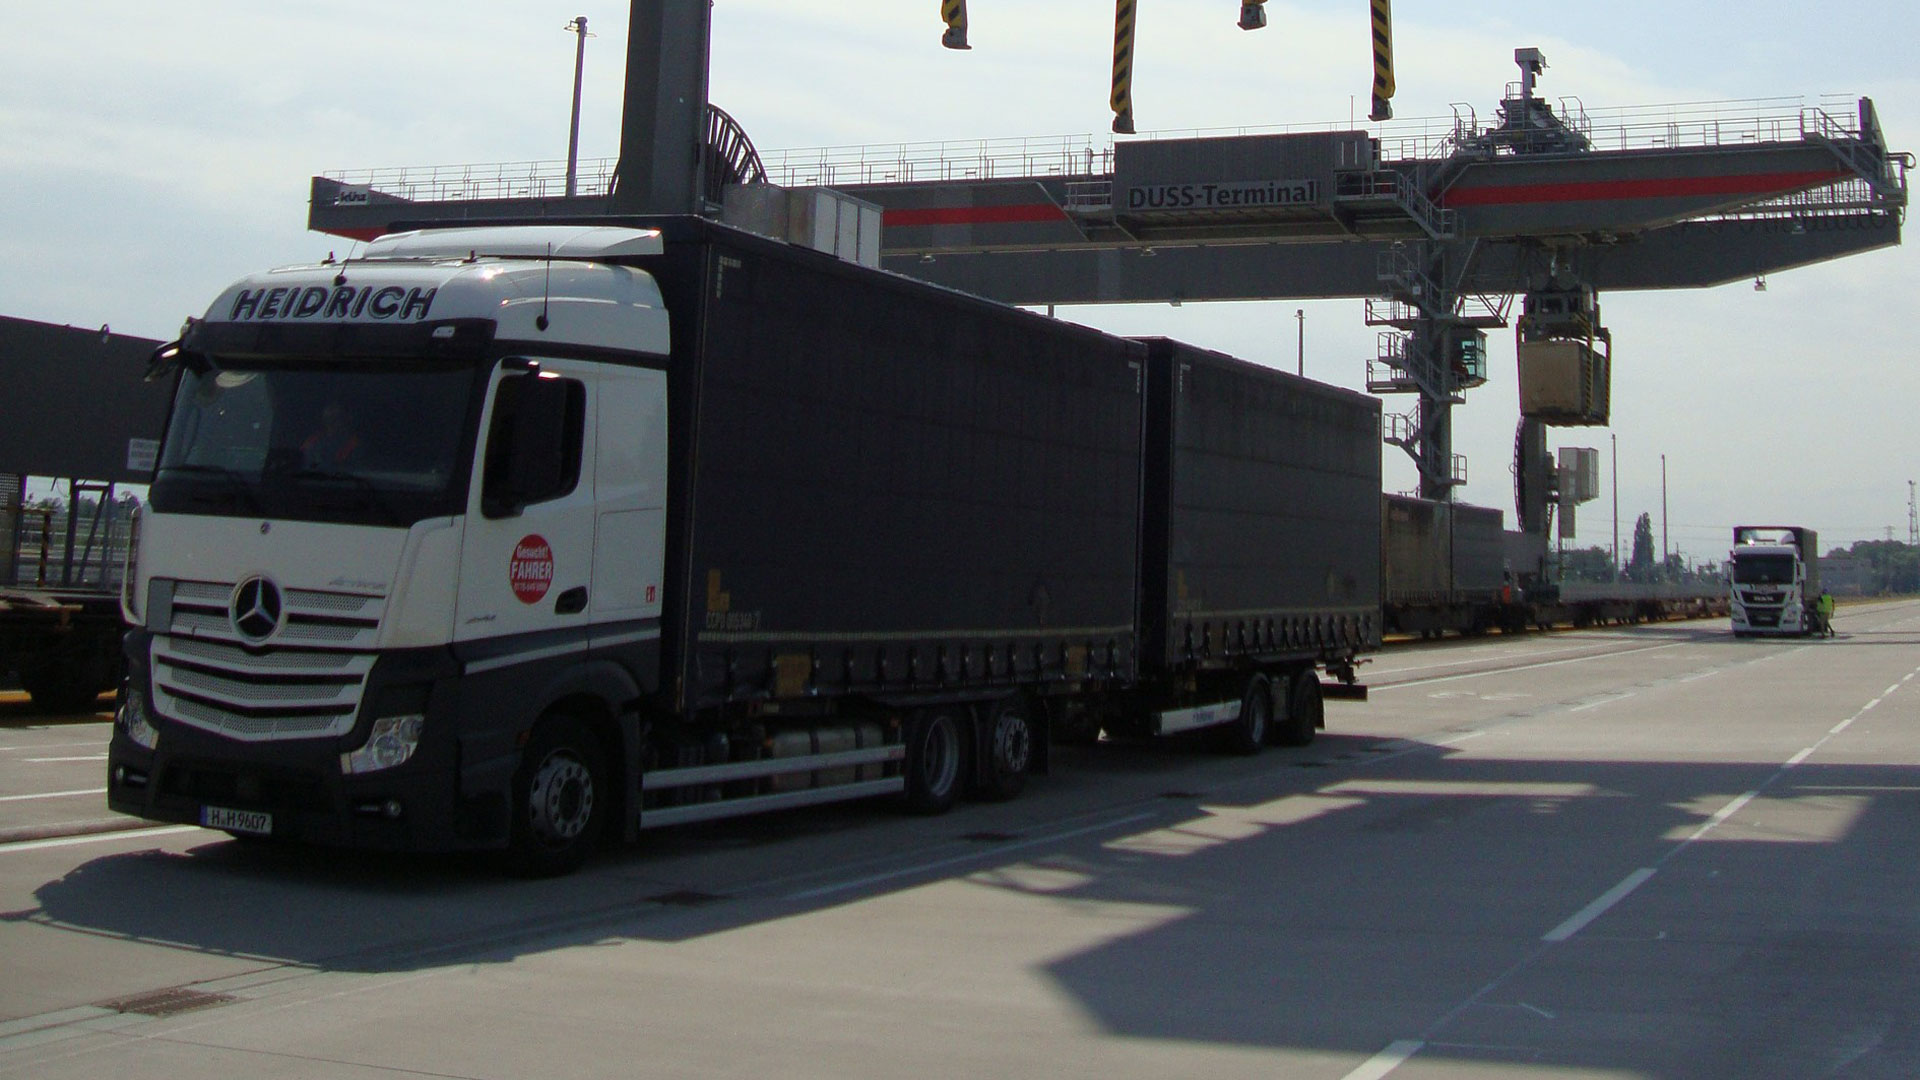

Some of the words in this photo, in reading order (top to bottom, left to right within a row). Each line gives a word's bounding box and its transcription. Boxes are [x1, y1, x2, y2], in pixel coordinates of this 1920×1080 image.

[1129, 181, 1315, 208] DUSS-Terminal
[229, 286, 438, 320] HEIDRICH
[511, 561, 552, 580] FAHRER
